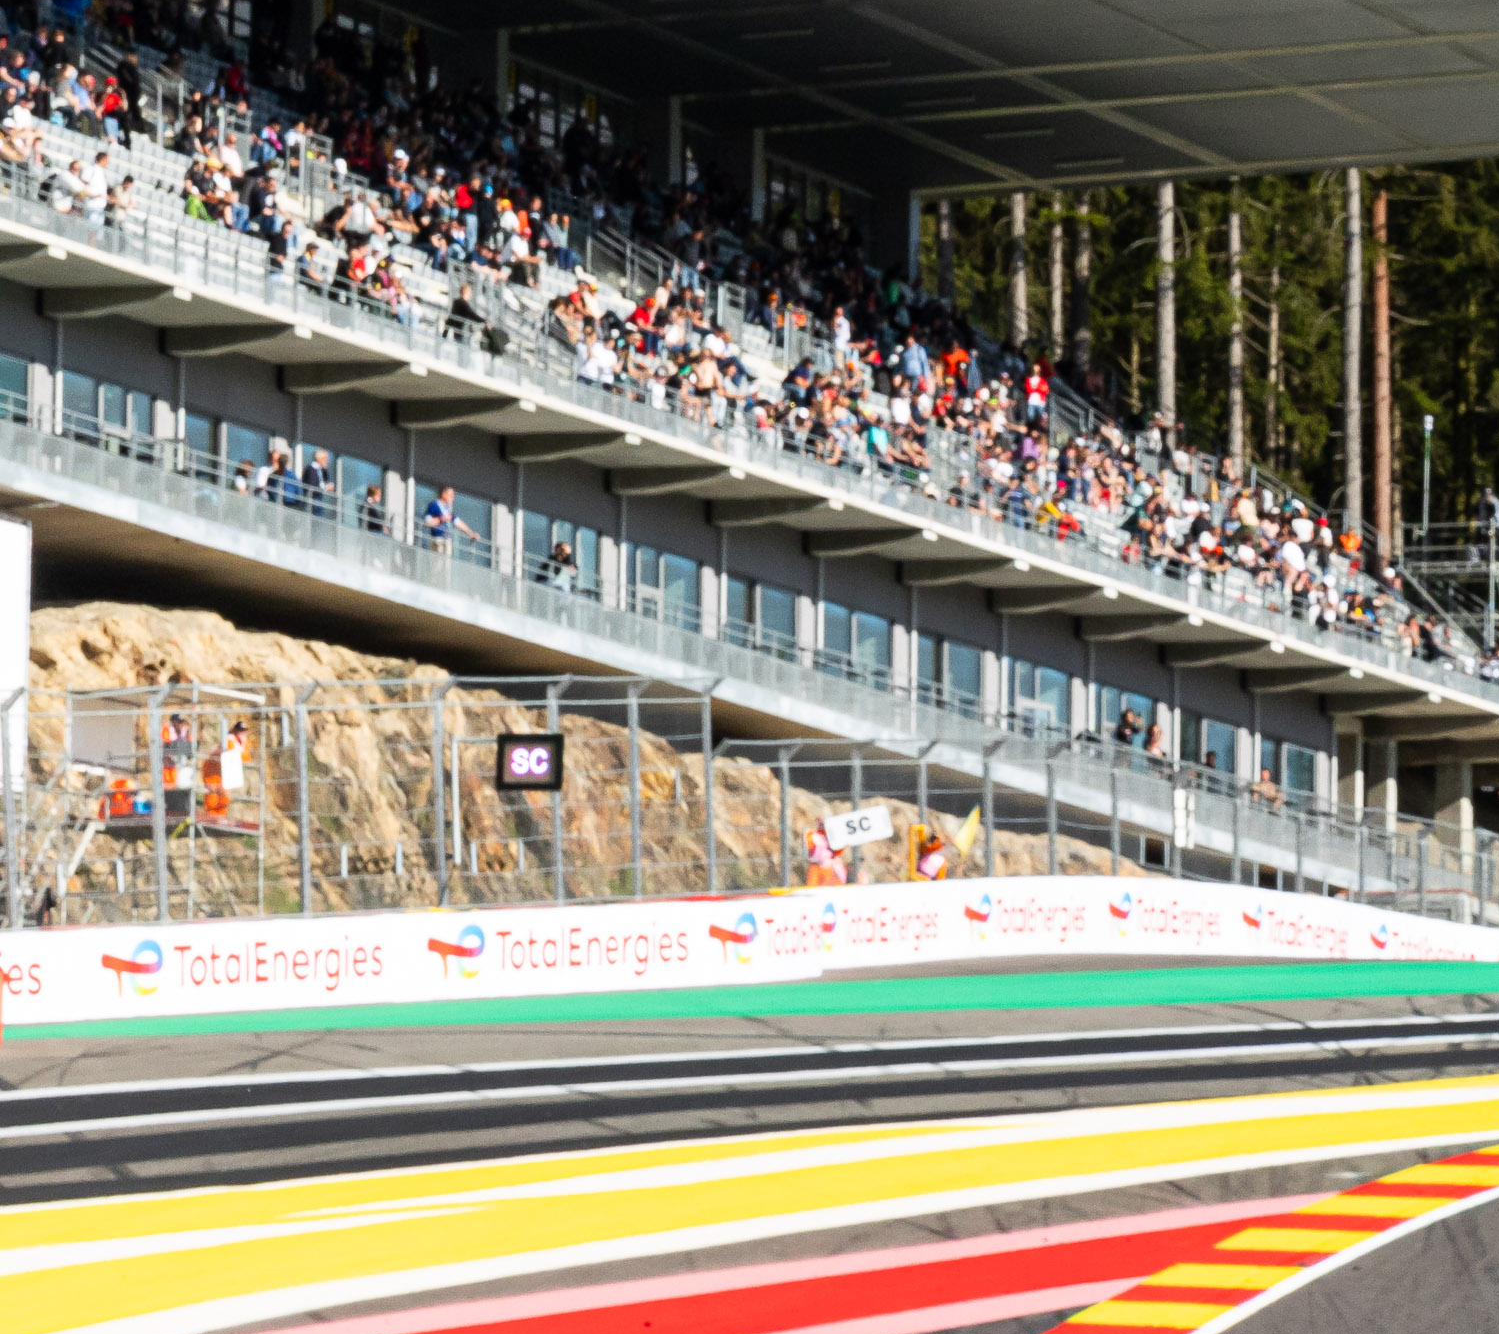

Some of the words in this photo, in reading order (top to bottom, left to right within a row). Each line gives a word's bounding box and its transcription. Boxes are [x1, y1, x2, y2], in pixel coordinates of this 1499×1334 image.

[510, 747, 549, 776] SC
[845, 816, 871, 835] SC
[496, 922, 688, 976] TotalEnergies
[842, 903, 938, 953] TotalEnergies
[174, 935, 382, 992] TotalEnergies
